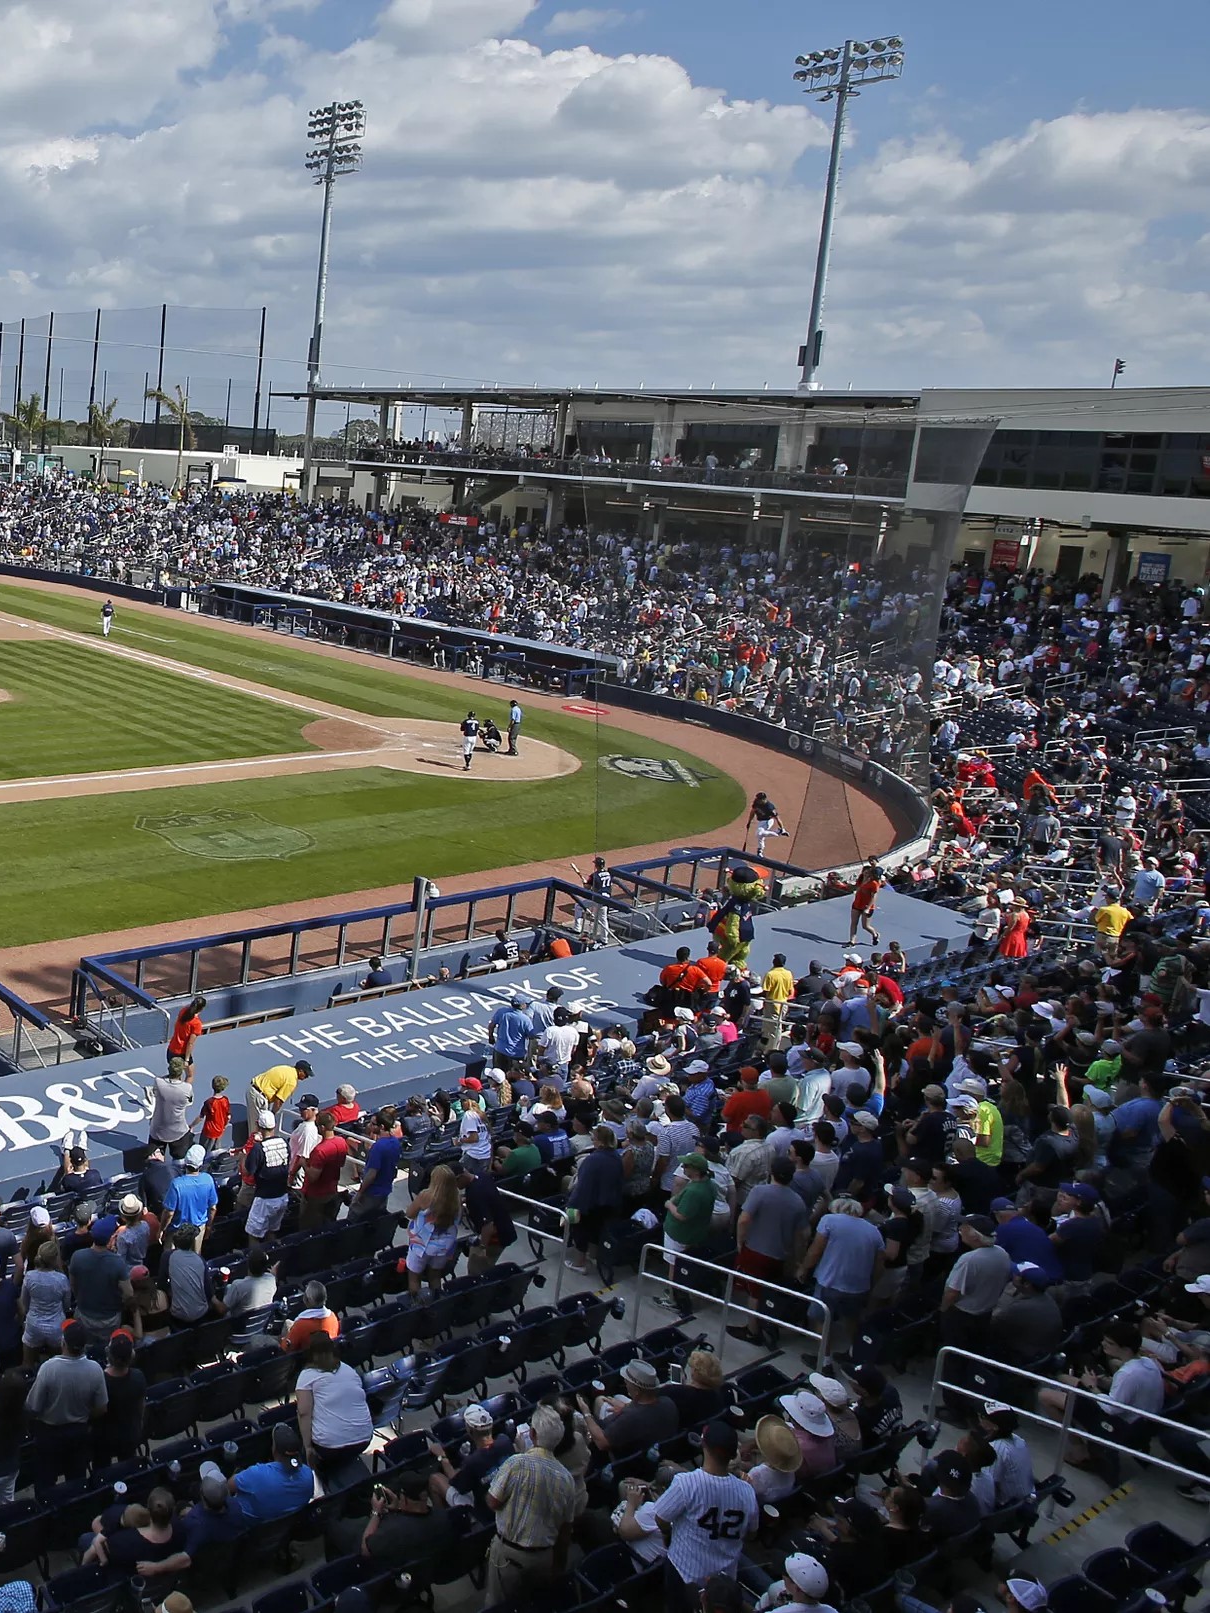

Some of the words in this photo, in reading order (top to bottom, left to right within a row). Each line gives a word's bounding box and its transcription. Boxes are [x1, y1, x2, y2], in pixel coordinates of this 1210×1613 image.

[1141, 567, 1166, 575] NEWS
[601, 876, 611, 887] 77
[507, 946, 519, 958] 55
[250, 1022, 359, 1058] THE
[347, 979, 550, 1039] BALLPARK
[544, 966, 604, 991] OF
[341, 1043, 418, 1070] THE
[406, 1022, 498, 1055] PALM
[697, 1506, 745, 1540] 42
